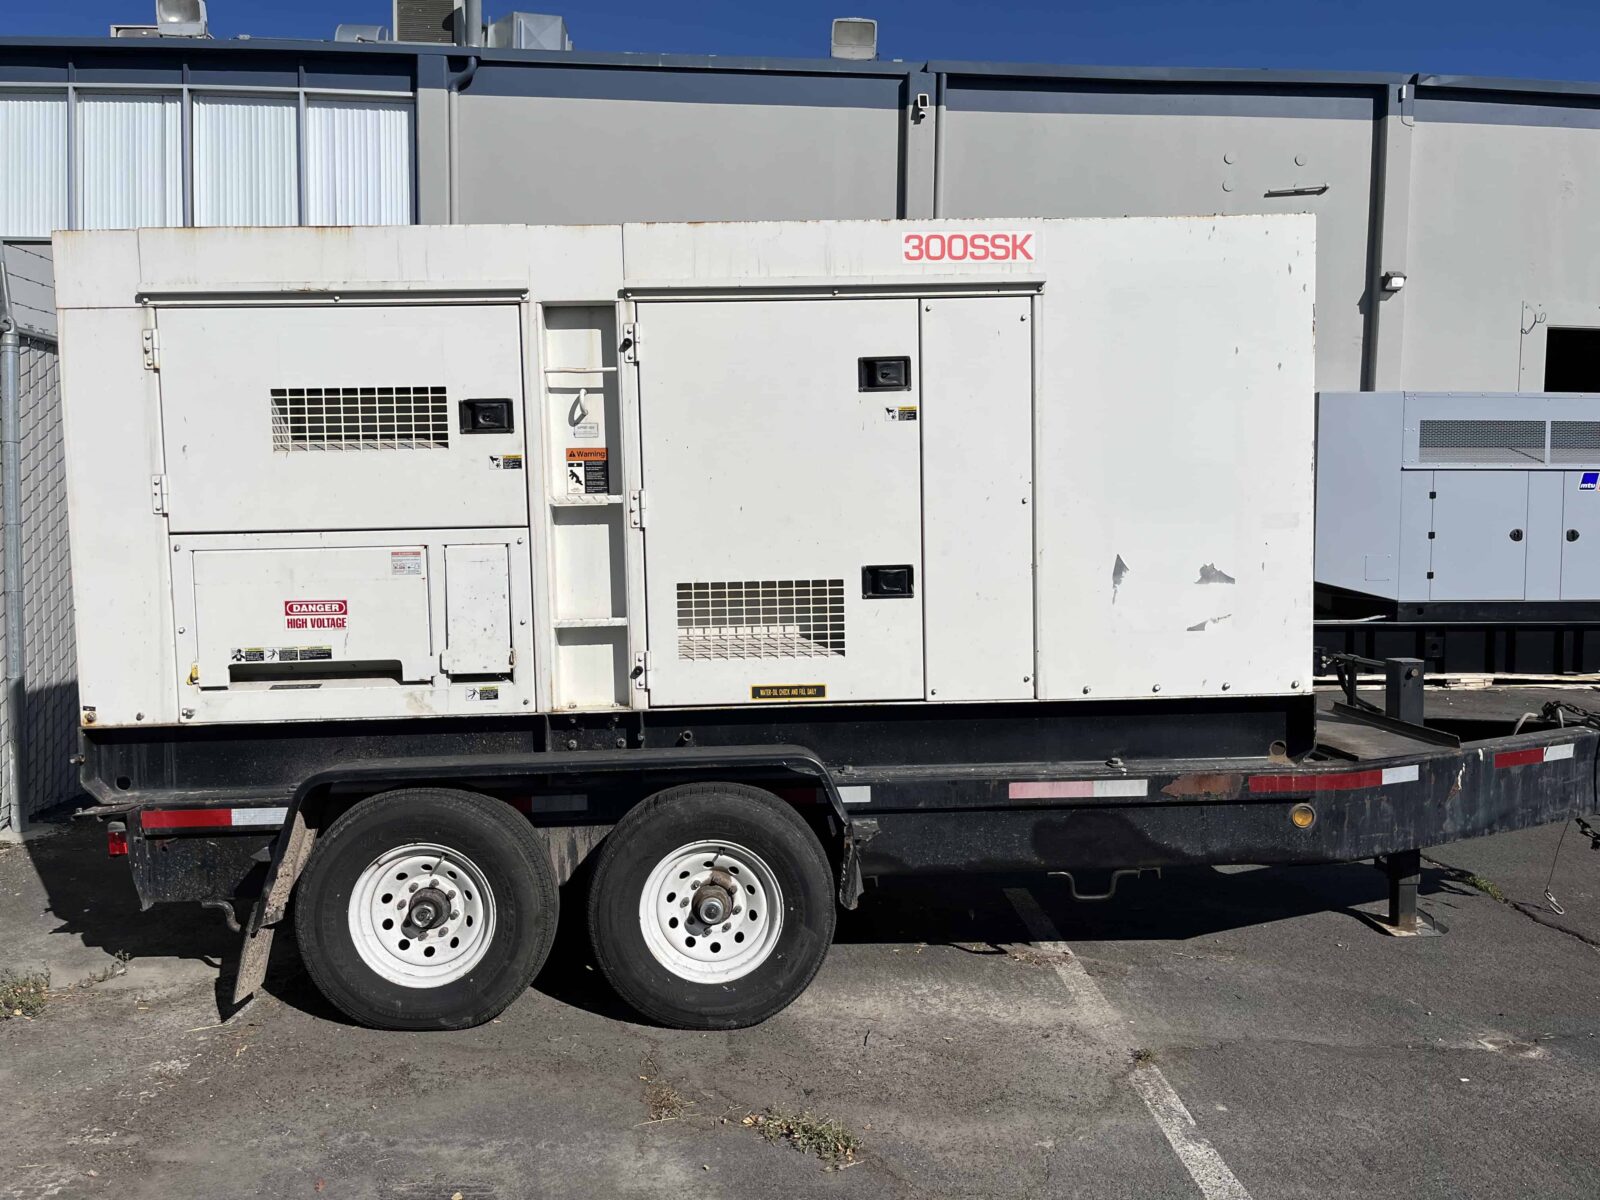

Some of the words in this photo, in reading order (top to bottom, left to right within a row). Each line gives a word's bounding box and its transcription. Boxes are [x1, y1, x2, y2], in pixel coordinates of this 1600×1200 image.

[904, 234, 1033, 260] 300SSK
[292, 604, 340, 612] DANGER
[287, 618, 308, 629] HIGH
[310, 617, 347, 629] VOLTAGE
